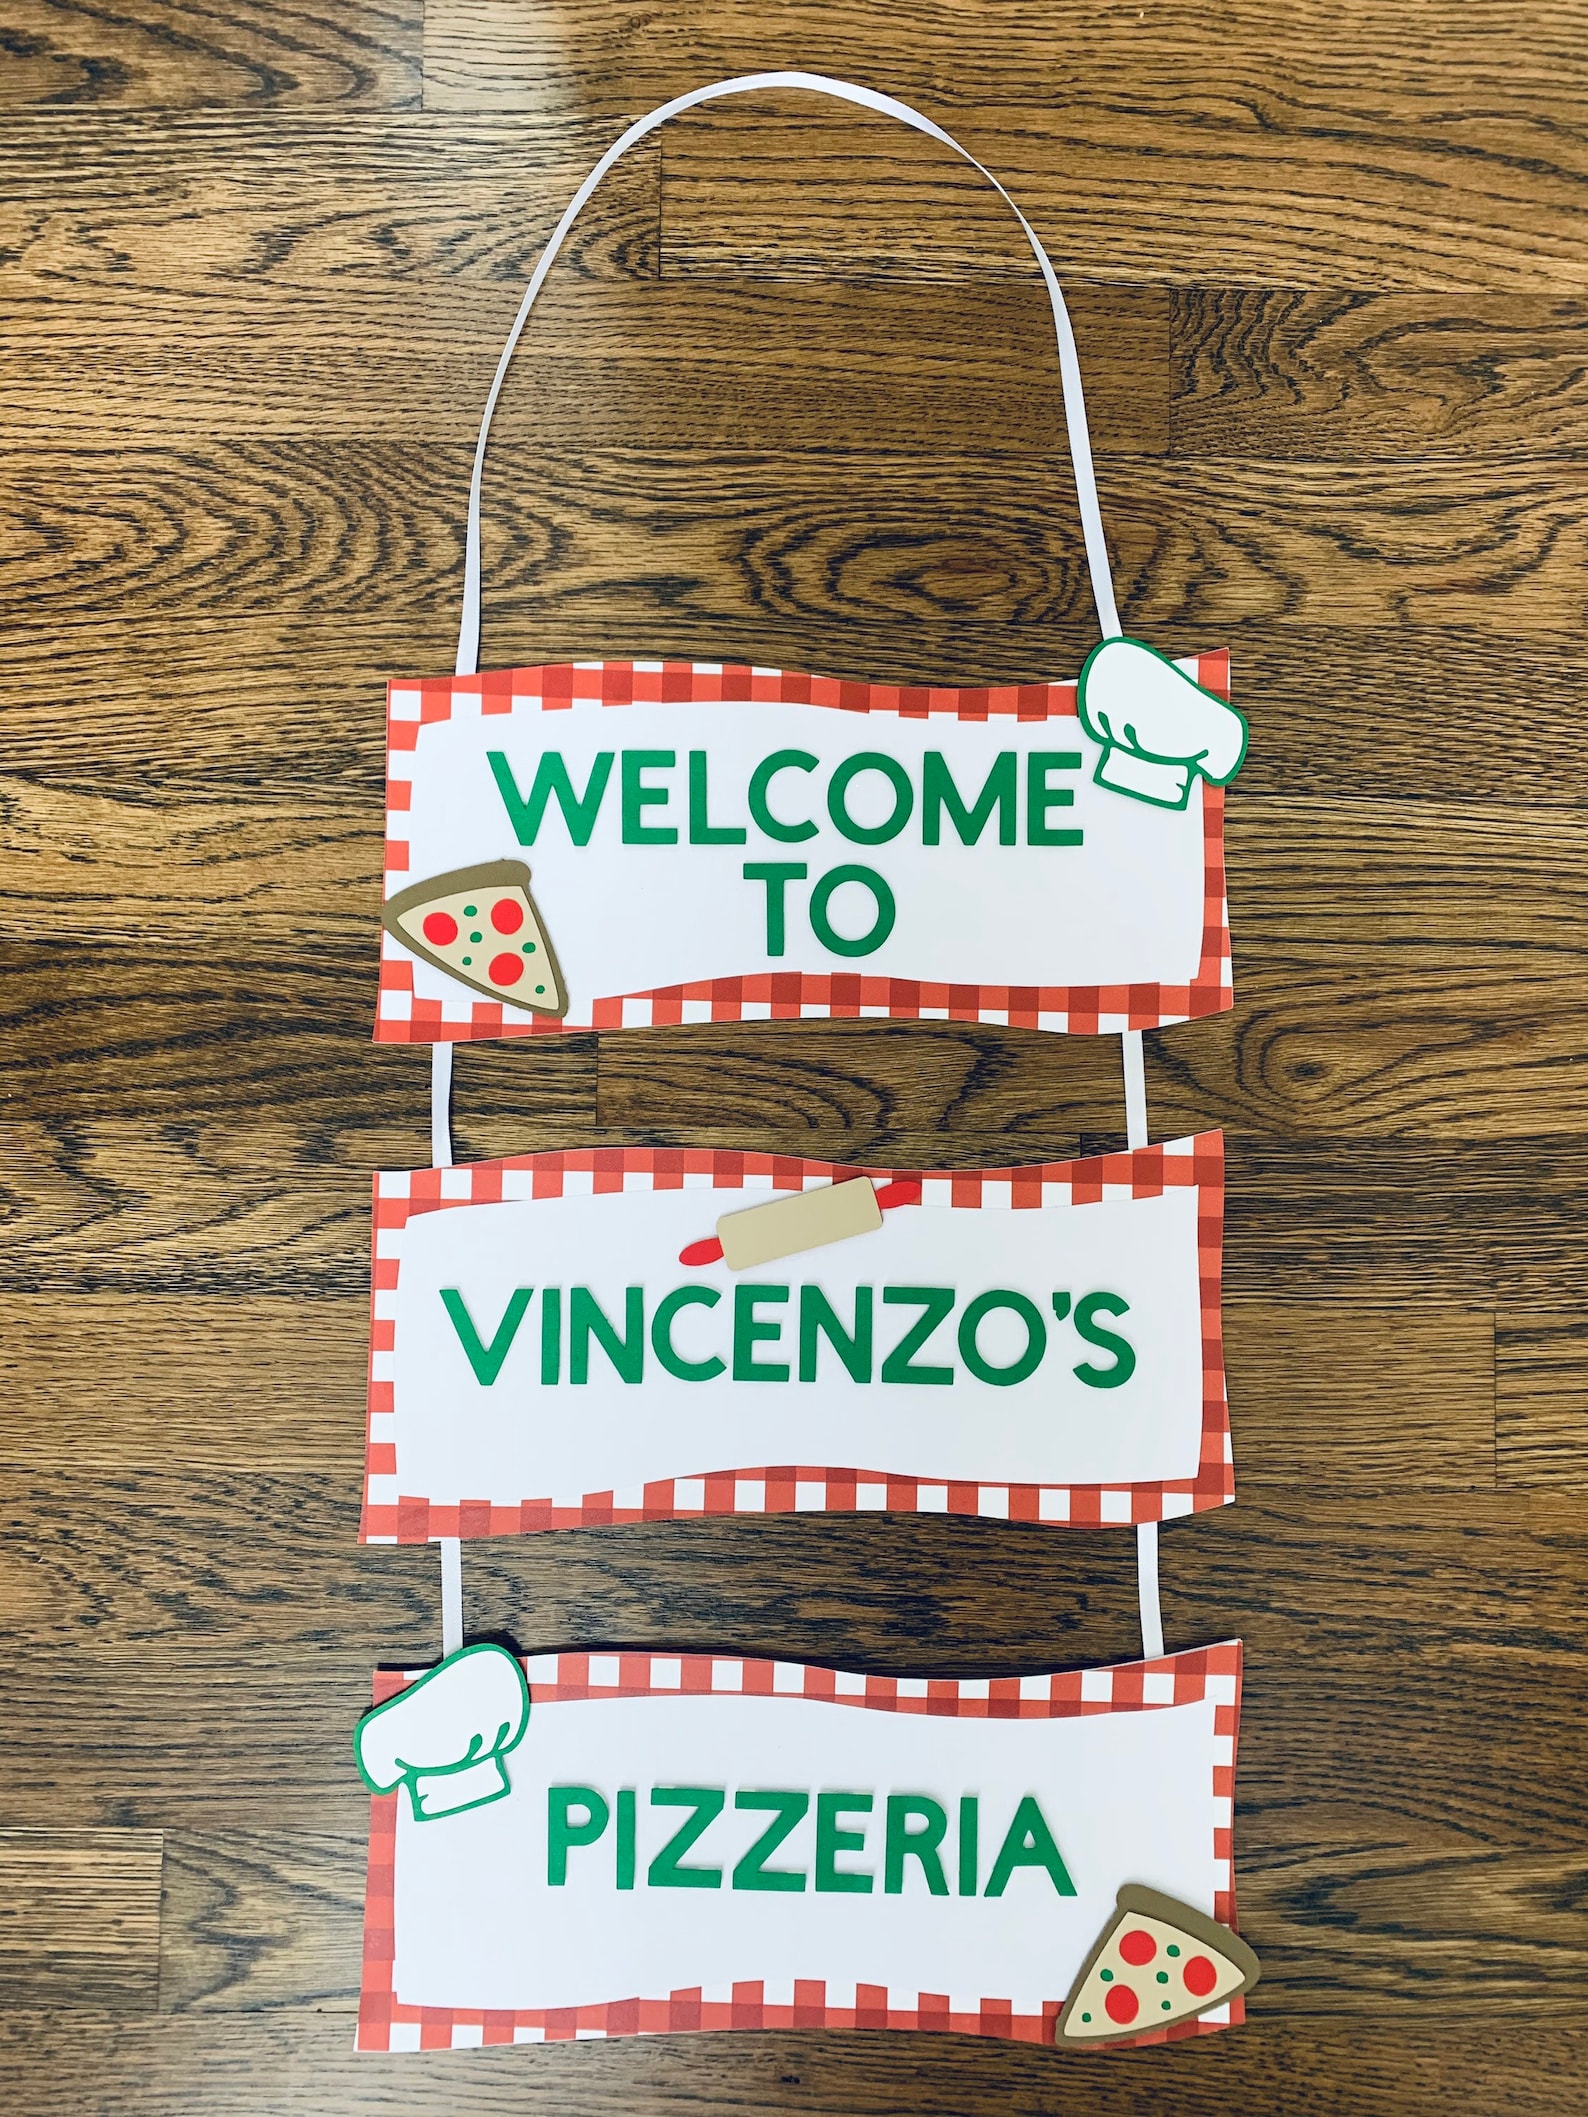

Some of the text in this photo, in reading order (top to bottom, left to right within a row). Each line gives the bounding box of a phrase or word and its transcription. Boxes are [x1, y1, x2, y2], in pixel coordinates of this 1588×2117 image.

[486, 749, 1084, 847] WELCOME
[742, 862, 896, 958] TO
[439, 1284, 1136, 1389] VINCENZO'S
[547, 1786, 1078, 1898] PIZZERIA
